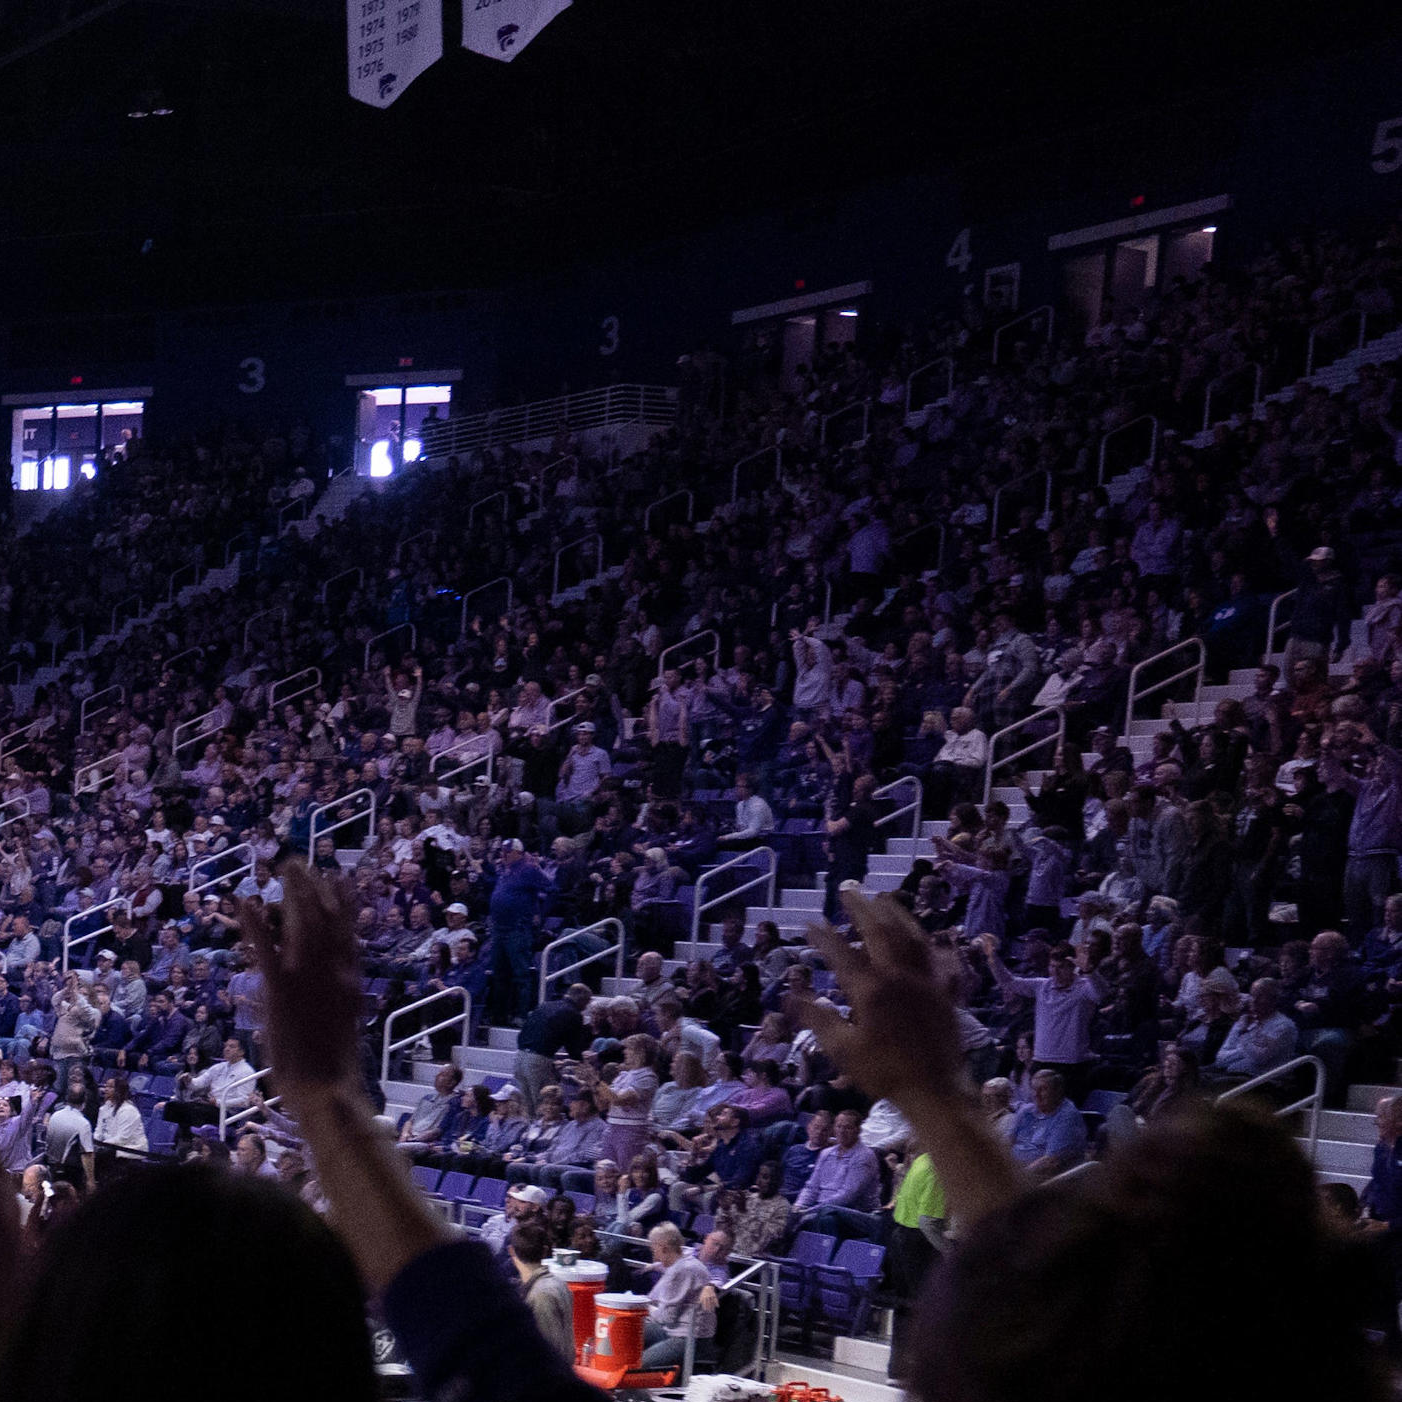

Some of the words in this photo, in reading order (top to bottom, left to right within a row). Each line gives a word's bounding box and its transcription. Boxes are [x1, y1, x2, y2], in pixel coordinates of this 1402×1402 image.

[947, 228, 972, 273] 4
[599, 314, 620, 356] 3
[238, 357, 266, 393] 3
